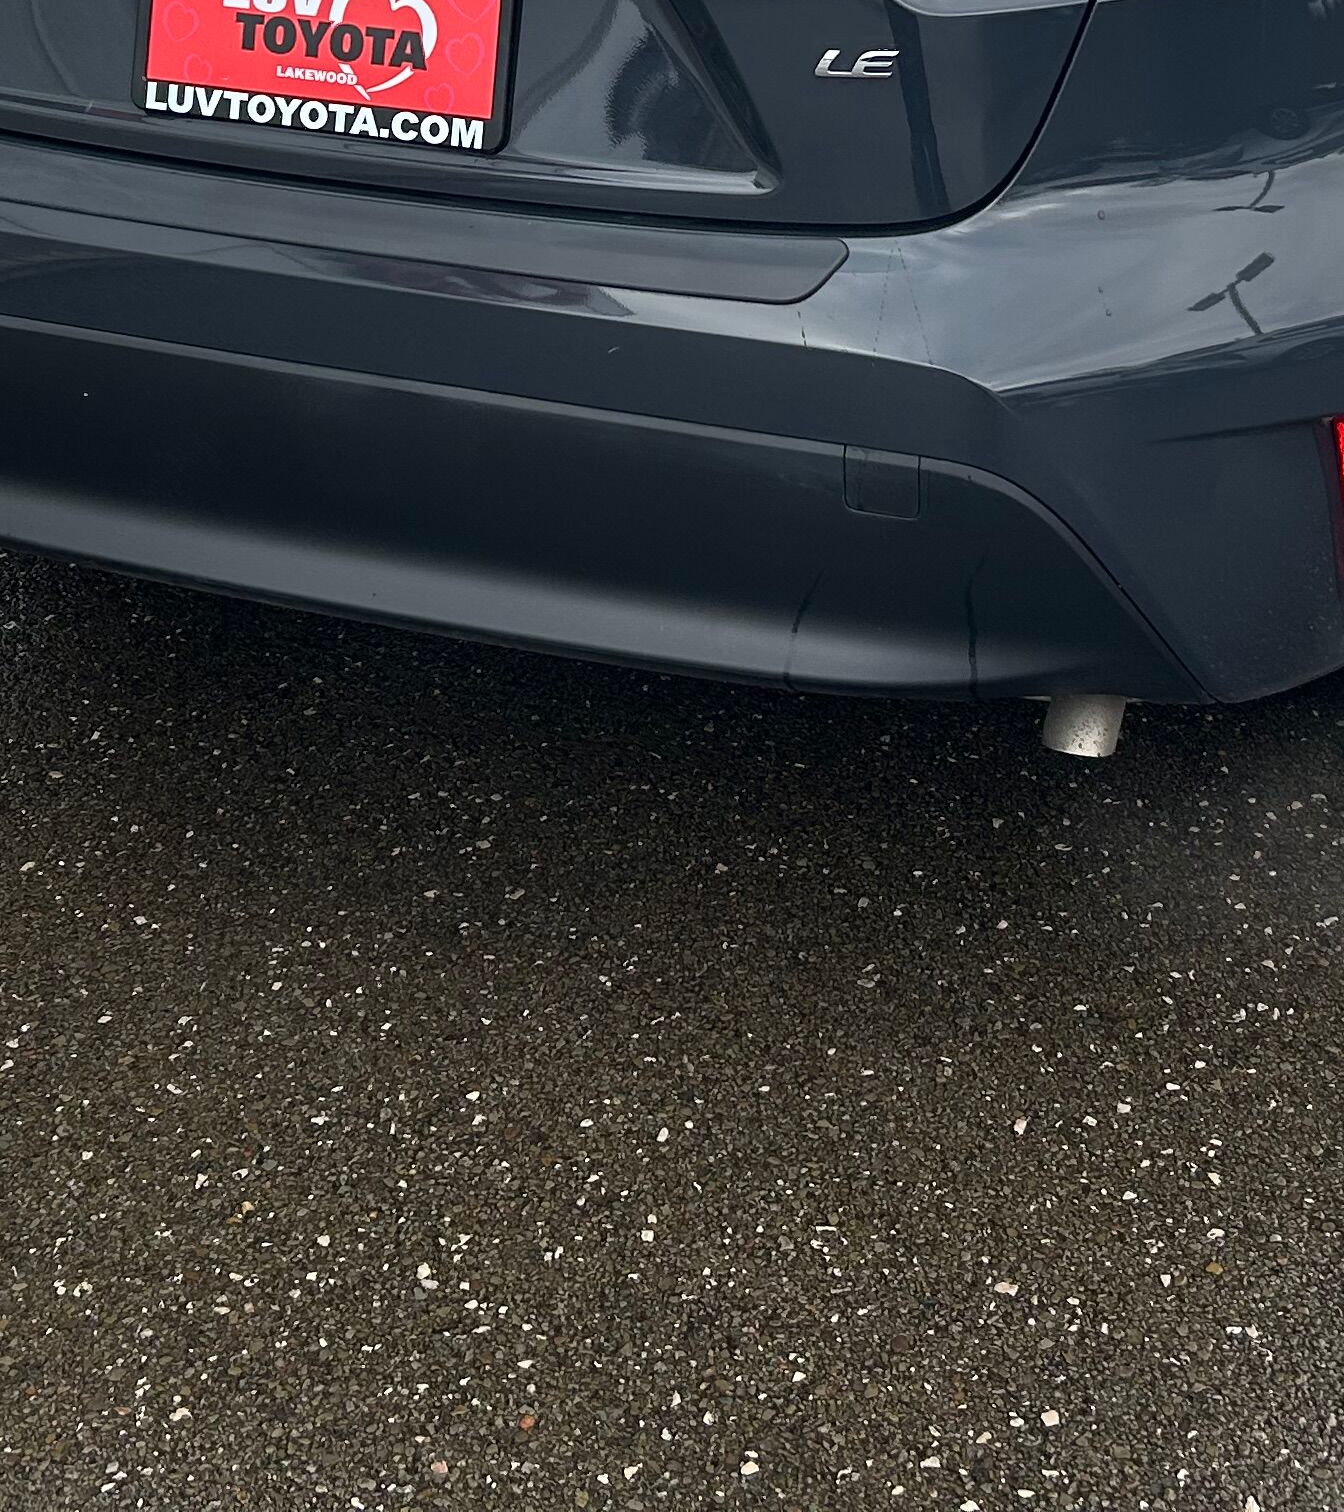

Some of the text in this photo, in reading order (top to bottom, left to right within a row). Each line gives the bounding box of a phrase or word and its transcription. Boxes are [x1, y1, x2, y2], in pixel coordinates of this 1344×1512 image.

[236, 12, 427, 71] TOYOTA
[276, 65, 358, 85] LAKEWOOD
[815, 49, 900, 79] LE
[145, 81, 484, 150] LUVTOYOTA.COM
